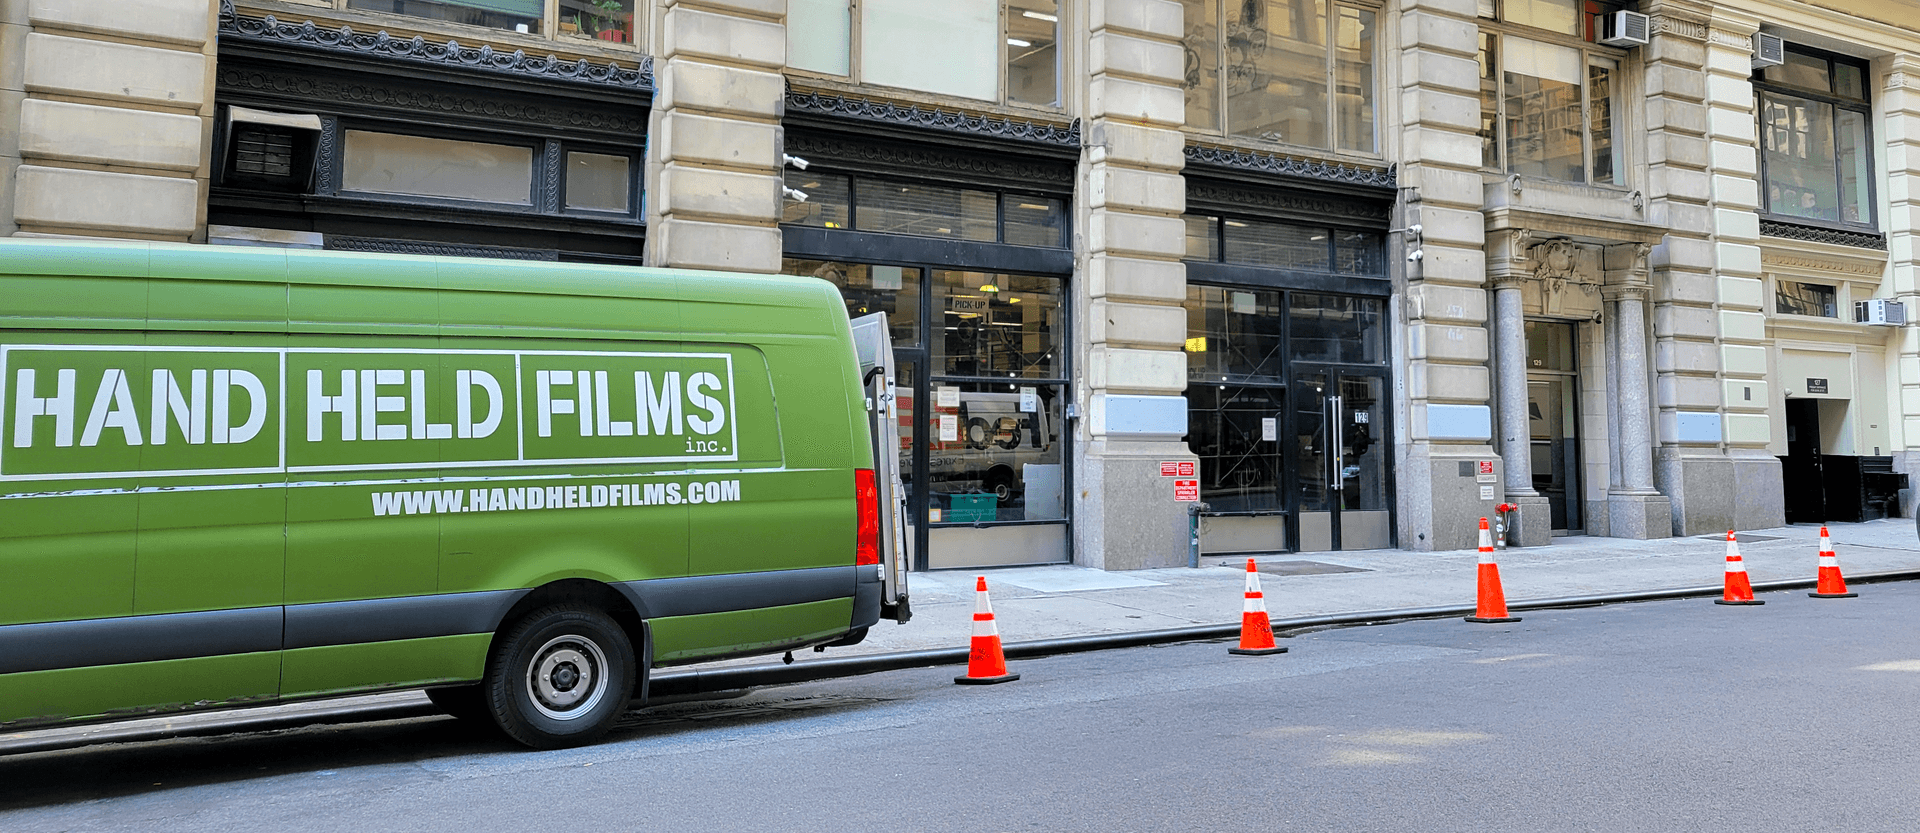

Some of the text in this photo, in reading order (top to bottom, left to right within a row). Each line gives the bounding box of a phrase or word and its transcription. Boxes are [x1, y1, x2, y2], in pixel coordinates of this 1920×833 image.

[954, 300, 986, 309] PICK-UP
[14, 368, 726, 448] HAND HELD FILMS
[1355, 412, 1369, 423] 129
[685, 436, 727, 453] inc.
[371, 479, 741, 516] WWW.HANDHELDFILMS.COM
